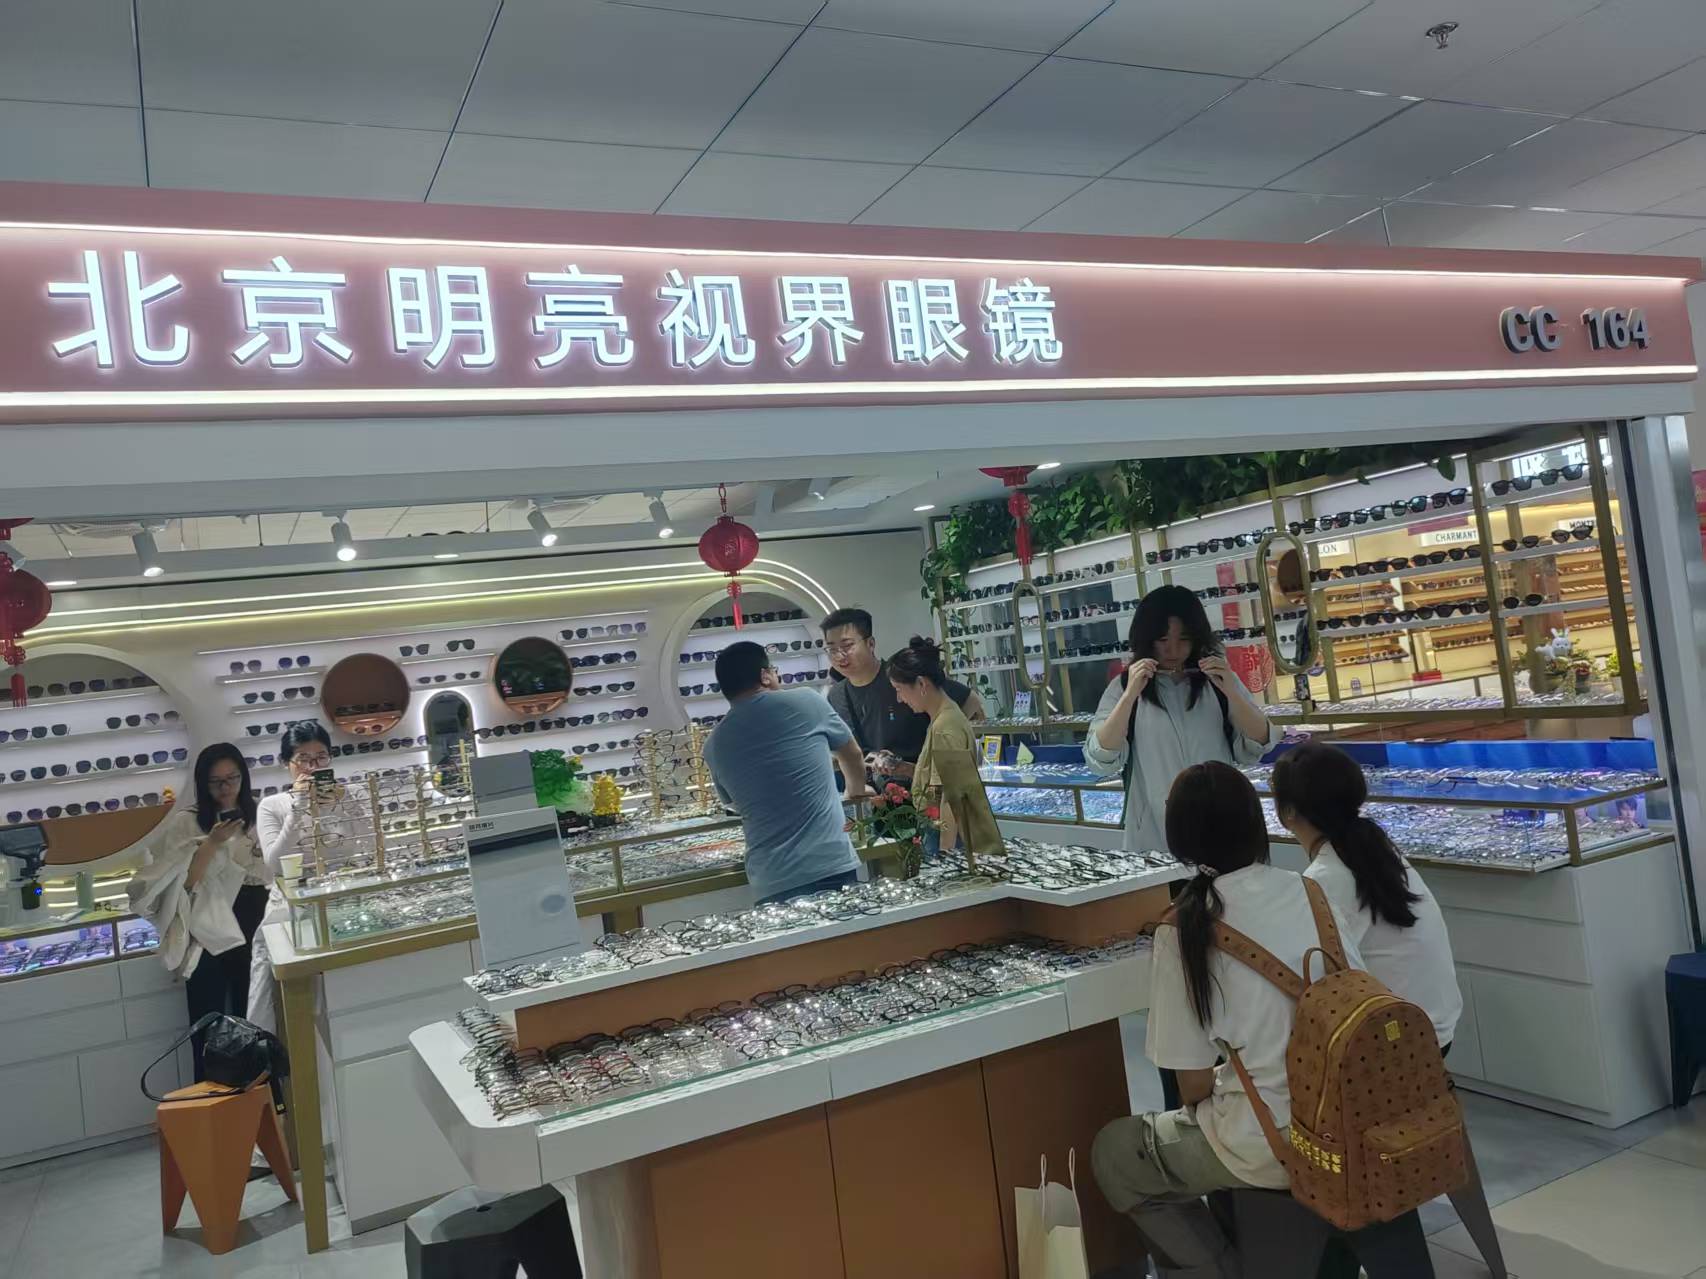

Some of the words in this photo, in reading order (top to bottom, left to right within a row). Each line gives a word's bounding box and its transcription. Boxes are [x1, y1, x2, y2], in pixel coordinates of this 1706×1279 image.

[47, 249, 1063, 369] 北京明亮视界眼镜
[1582, 307, 1649, 350] 164
[1435, 530, 1477, 543] CHARMANT
